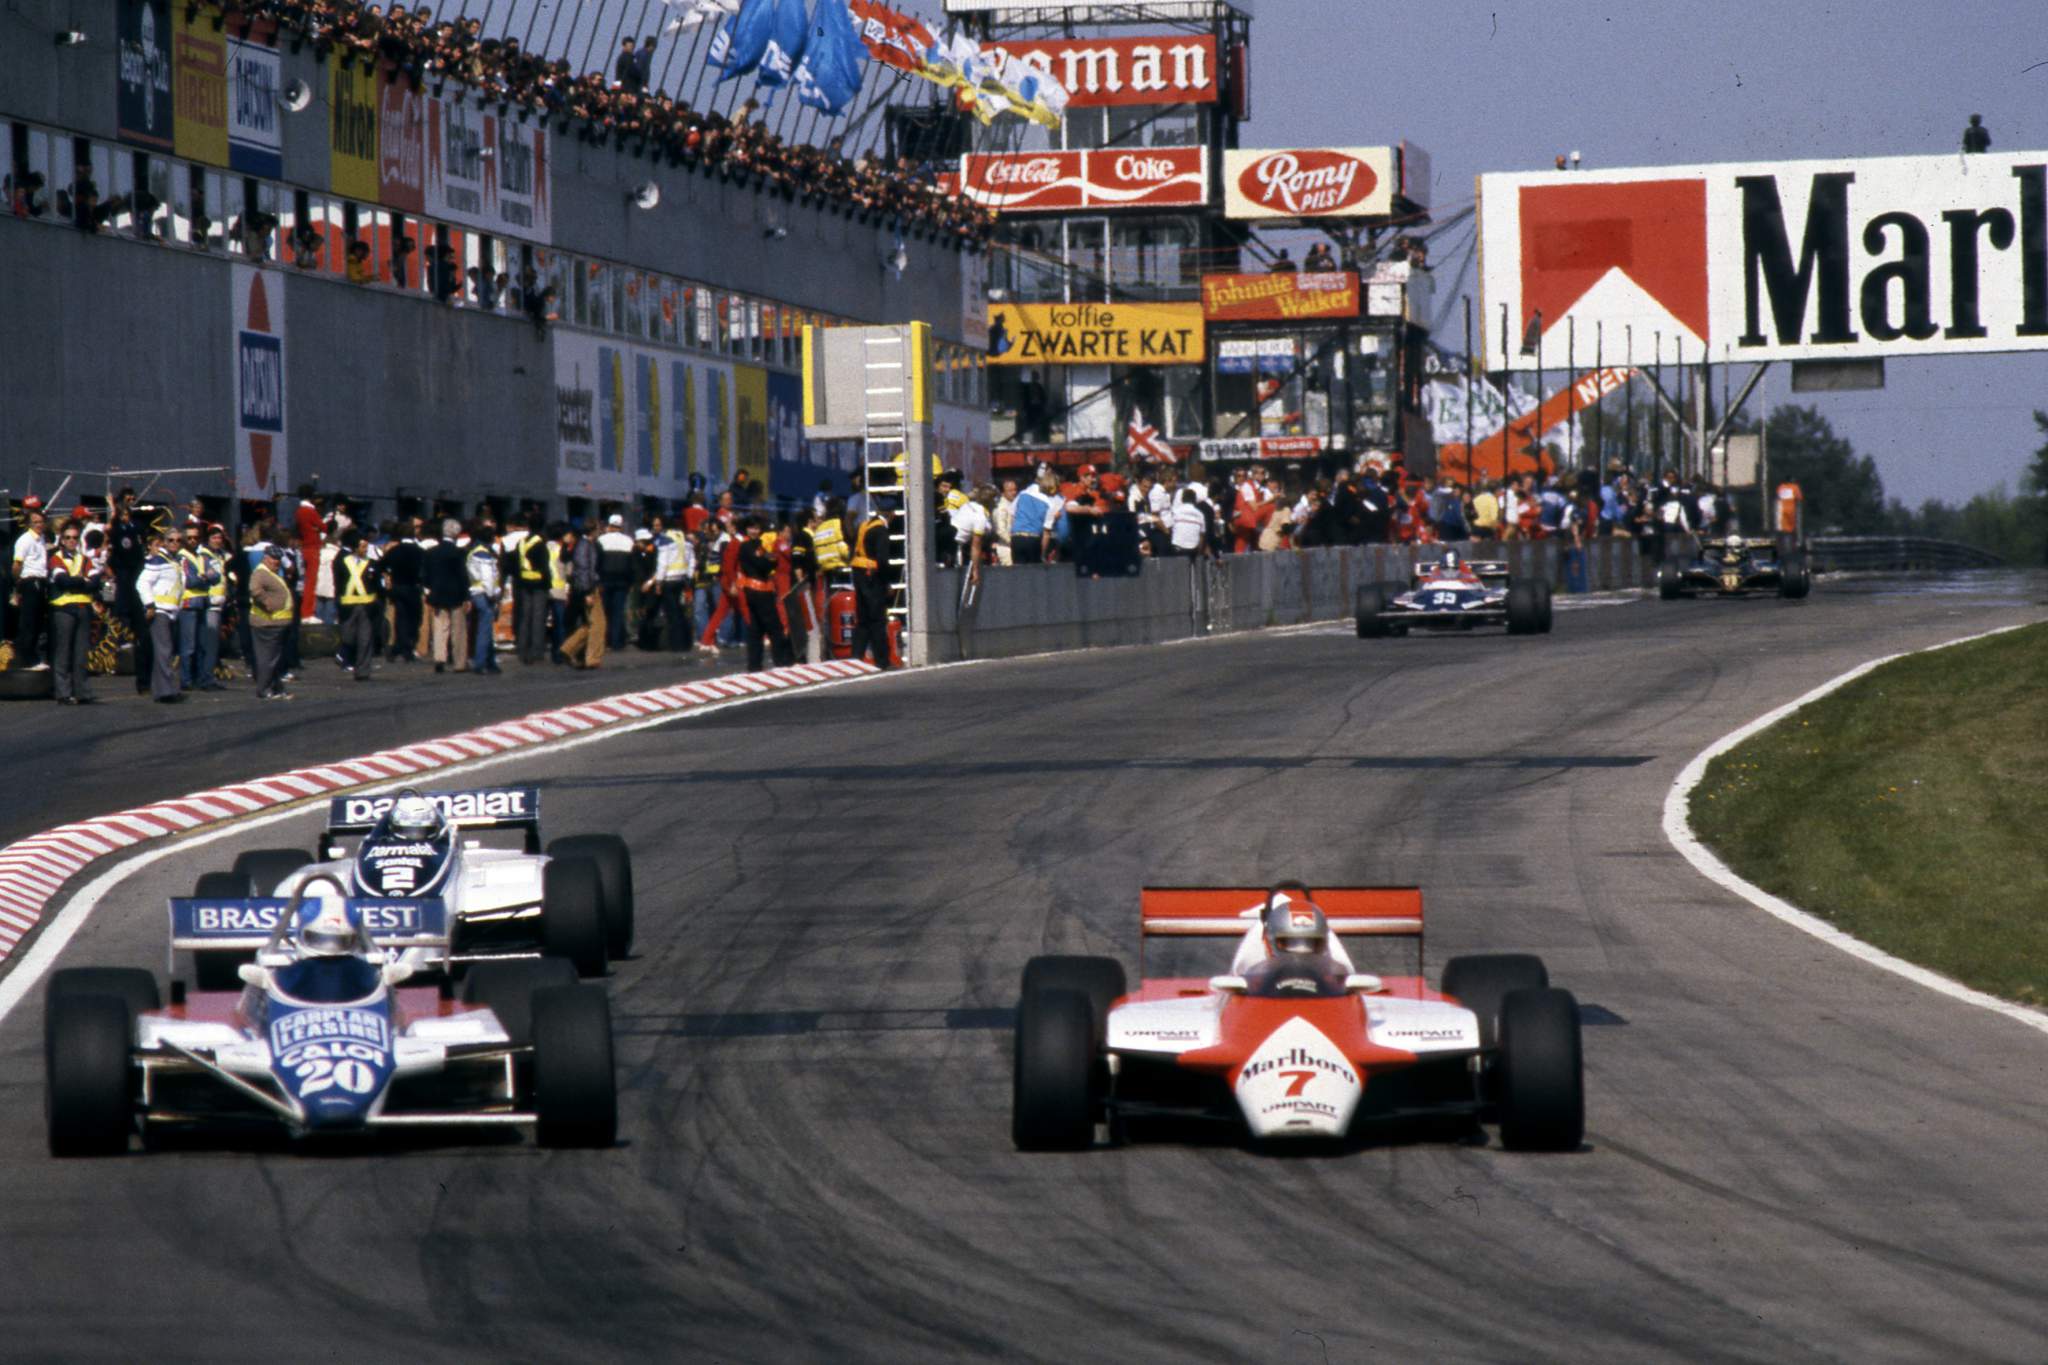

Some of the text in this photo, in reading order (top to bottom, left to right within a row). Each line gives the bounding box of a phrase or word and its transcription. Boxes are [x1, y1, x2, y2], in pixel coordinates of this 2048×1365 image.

[1115, 154, 1175, 181] Coke
[1256, 152, 1358, 212] Romy
[1301, 188, 1337, 211] PILS
[1205, 273, 1292, 314] Johnnie
[1275, 289, 1351, 318] Walker
[1050, 304, 1114, 327] koffie
[1020, 329, 1128, 356] ZWARTE
[1140, 329, 1192, 355] KAT
[345, 791, 525, 824] pamalat
[364, 842, 438, 861] parmalat
[382, 867, 415, 890] 2
[282, 1042, 384, 1068] CALOI
[1242, 1048, 1354, 1084] Marlboro
[296, 1059, 375, 1098] 20
[1278, 1071, 1316, 1097] 7
